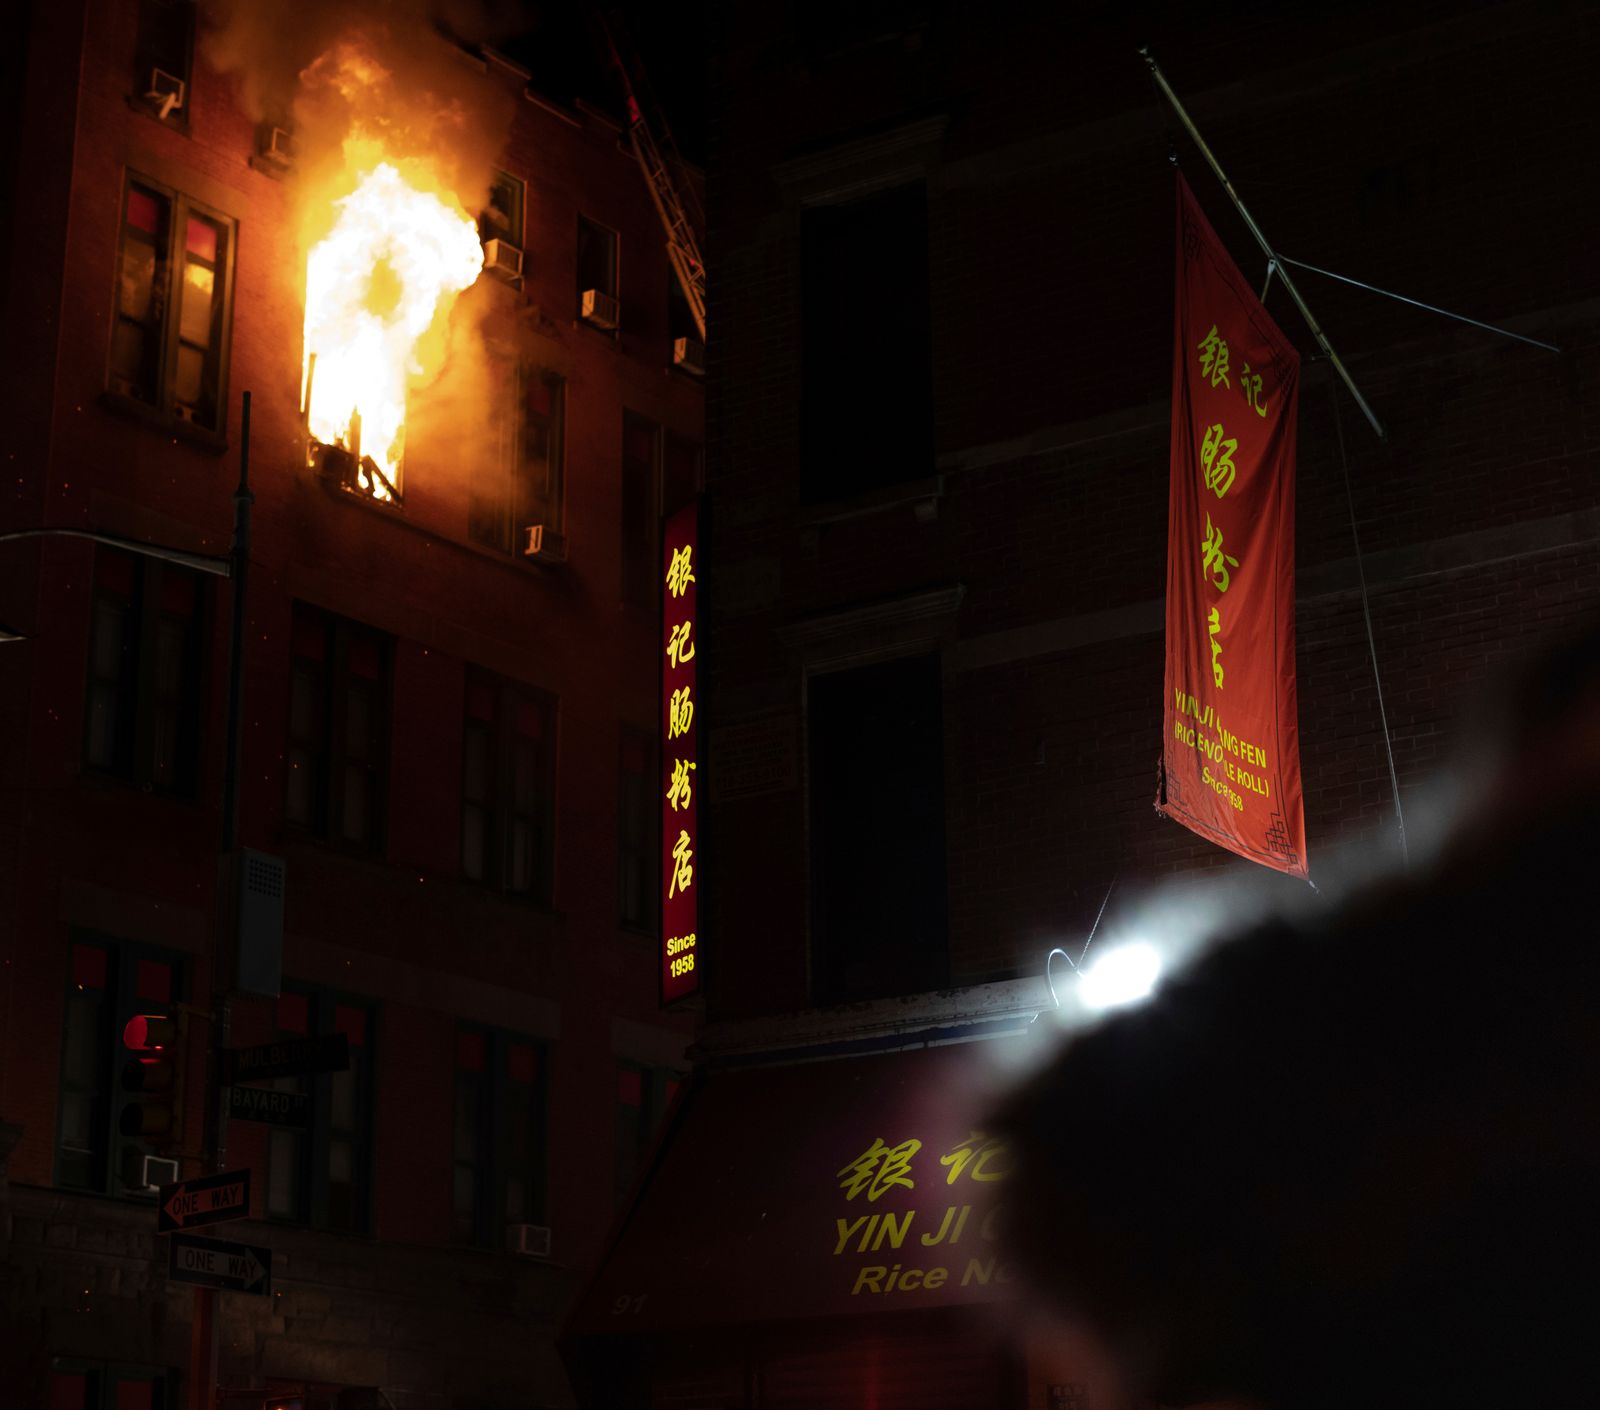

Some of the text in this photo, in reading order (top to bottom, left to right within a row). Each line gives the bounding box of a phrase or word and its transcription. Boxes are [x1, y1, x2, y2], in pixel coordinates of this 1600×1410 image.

[665, 544, 697, 900] 银记肠粉店
[1175, 687, 1267, 769] YIN JI FEN
[1237, 766, 1269, 799] ROLL)
[666, 932, 697, 956] Since
[670, 953, 695, 978] 1958
[232, 1087, 290, 1114] BAYARD
[172, 1184, 240, 1215] ONE WAY
[832, 1209, 916, 1255] YIN
[920, 1204, 972, 1247] JI
[185, 1249, 257, 1278] ONE WAY
[849, 1263, 949, 1296] Rice
[610, 1293, 649, 1316] 91
